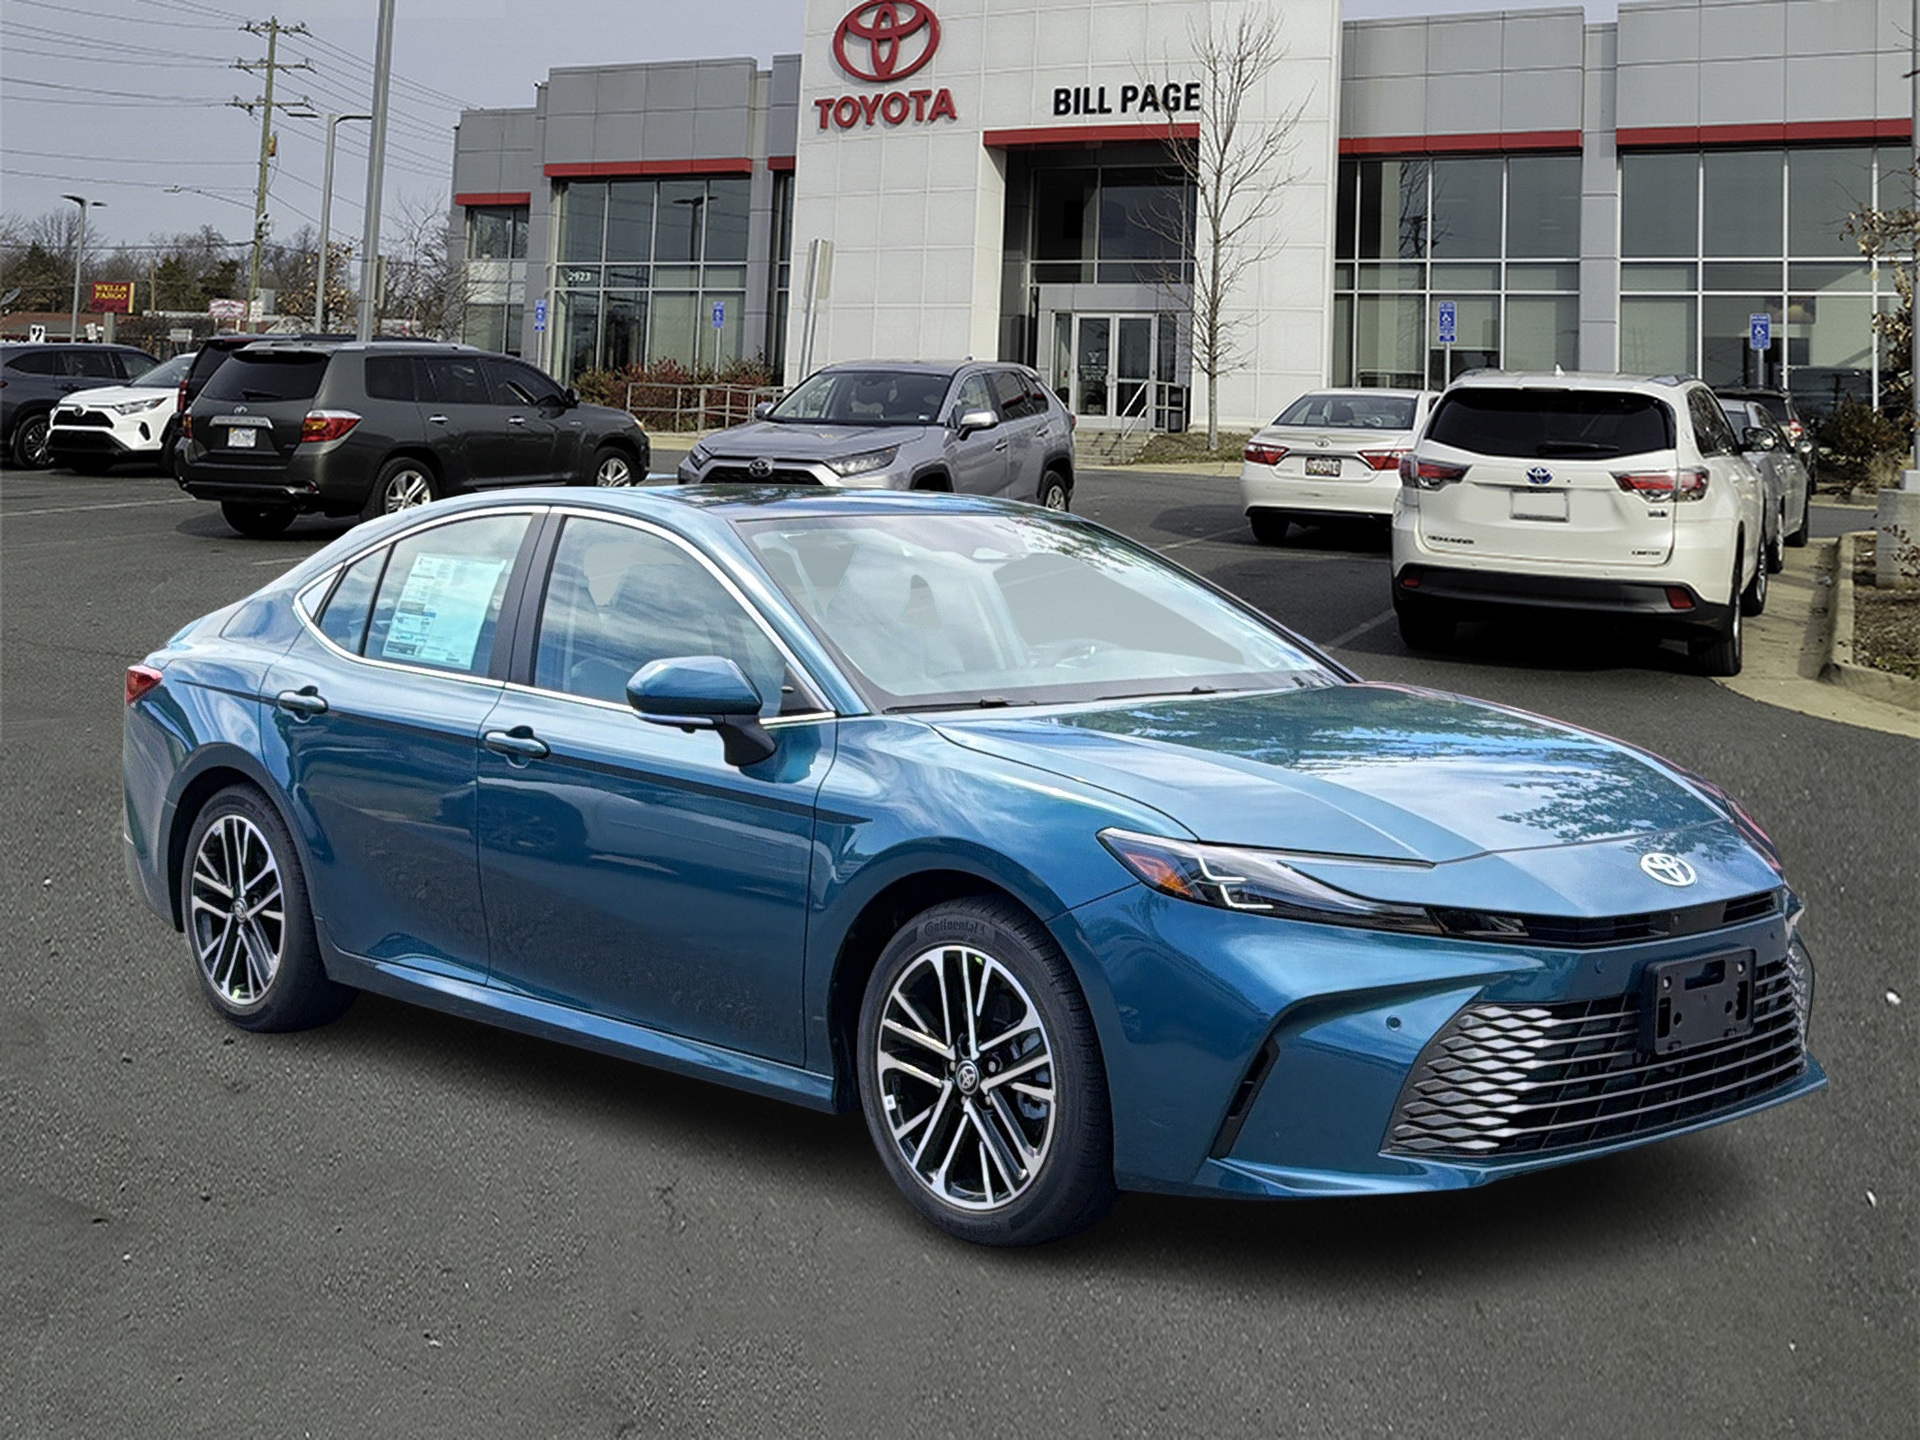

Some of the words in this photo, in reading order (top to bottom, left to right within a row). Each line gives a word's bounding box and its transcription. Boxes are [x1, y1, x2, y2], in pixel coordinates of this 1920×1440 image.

[814, 88, 957, 129] TOYOTA
[1053, 87, 1112, 115] BILL
[1121, 83, 1201, 113] PAGE
